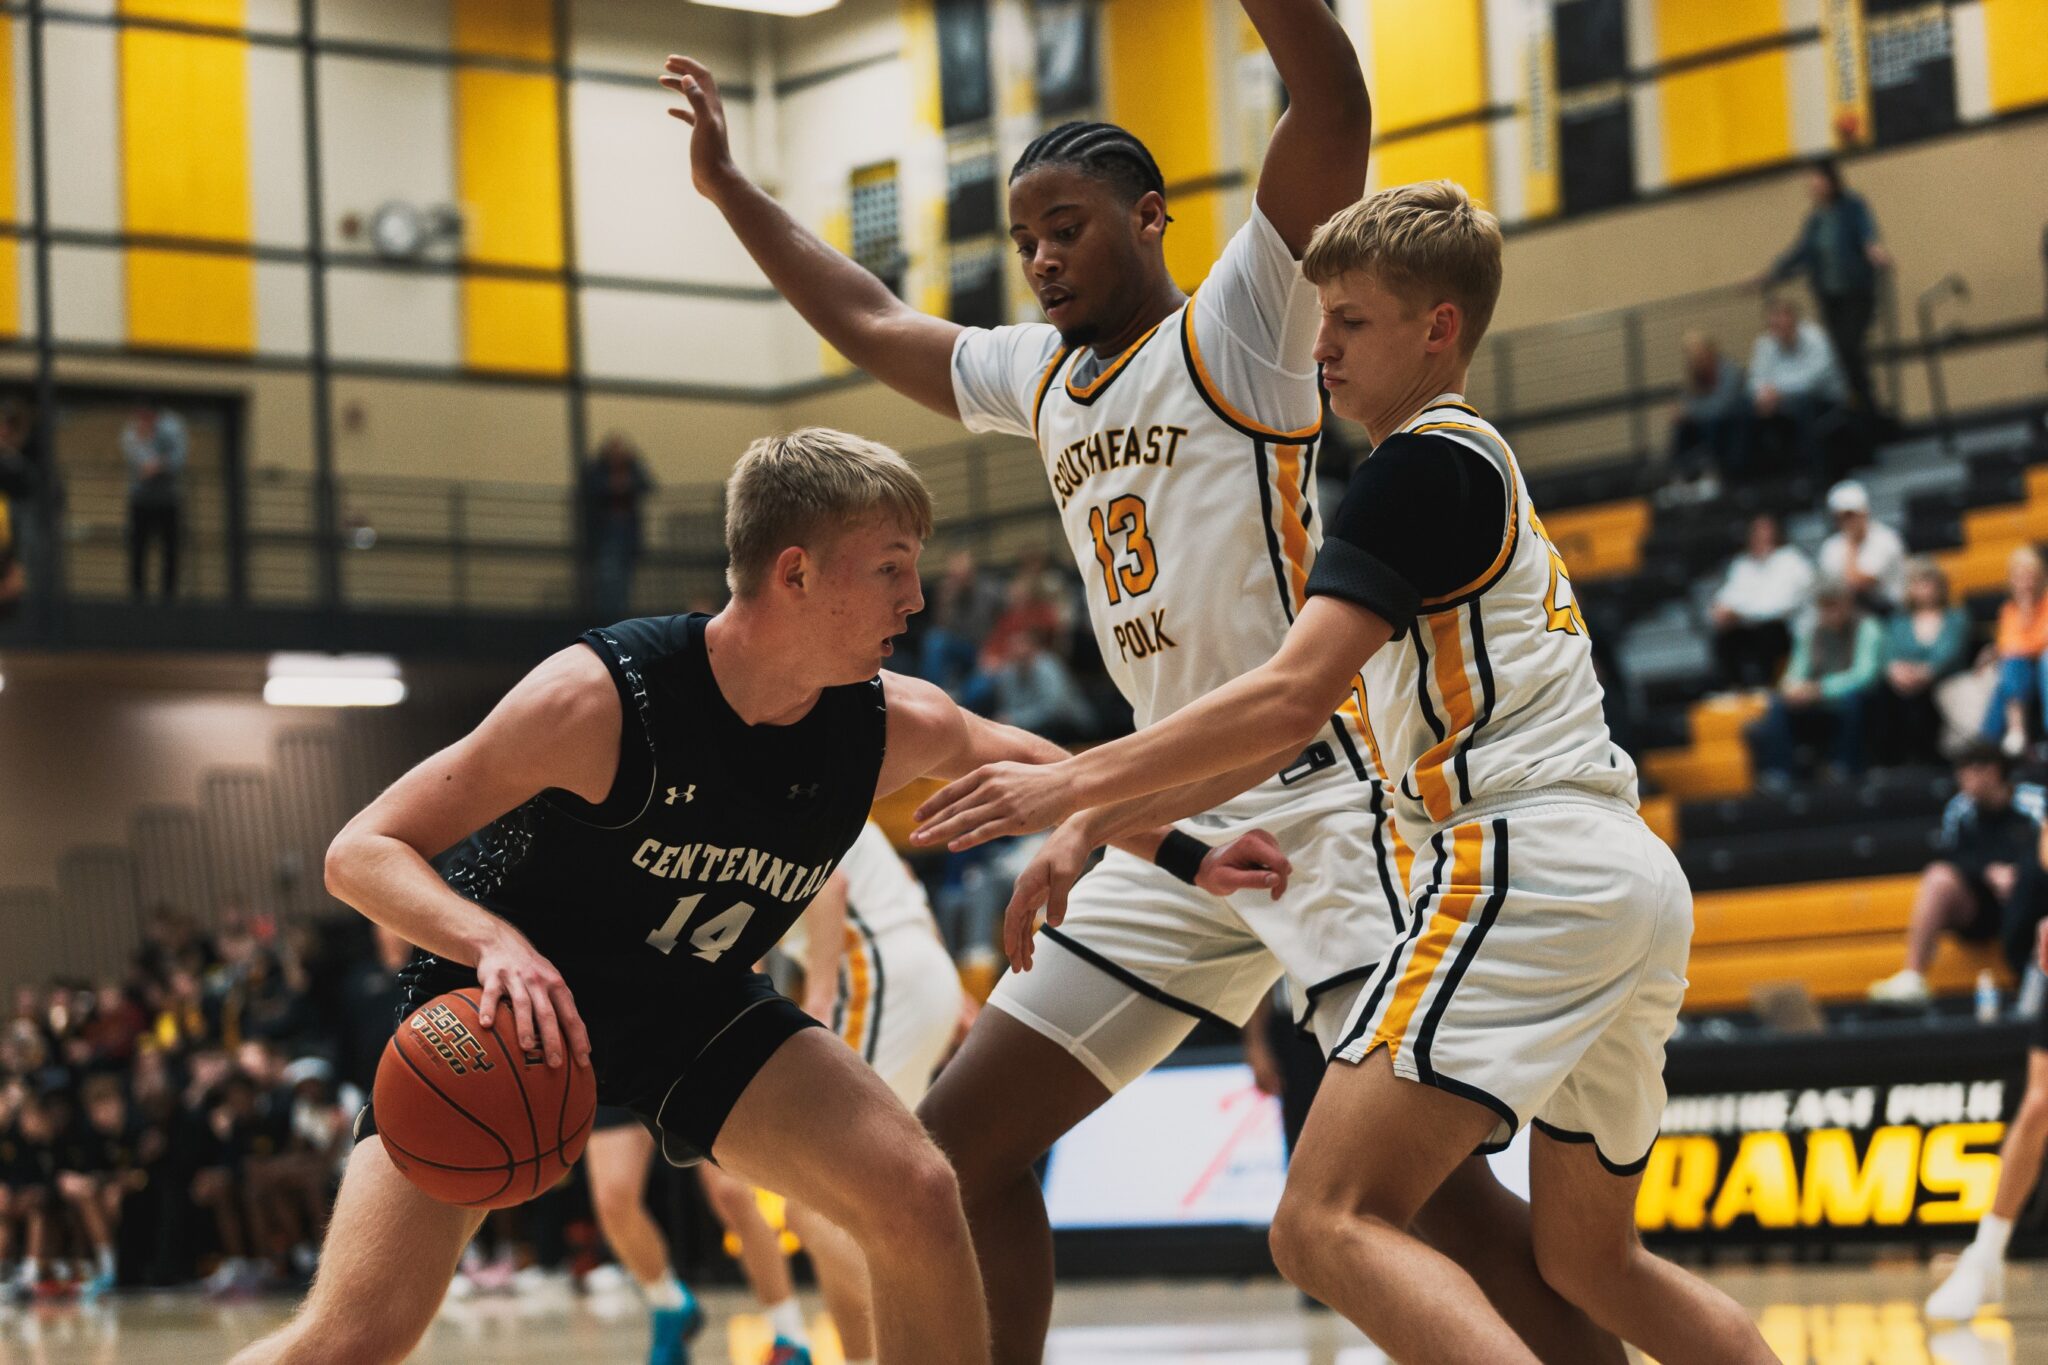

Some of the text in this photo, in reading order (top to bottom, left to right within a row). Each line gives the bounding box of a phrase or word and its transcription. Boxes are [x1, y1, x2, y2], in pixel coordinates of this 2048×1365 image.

[1053, 425, 1188, 510] SOUTHEAST
[1088, 493, 1159, 607] 13
[1113, 608, 1178, 664] POLK
[632, 838, 833, 903] CENTENNIAL
[645, 892, 756, 963] 14
[419, 1023, 467, 1076] 1000
[1635, 1122, 2006, 1231] RAMS
